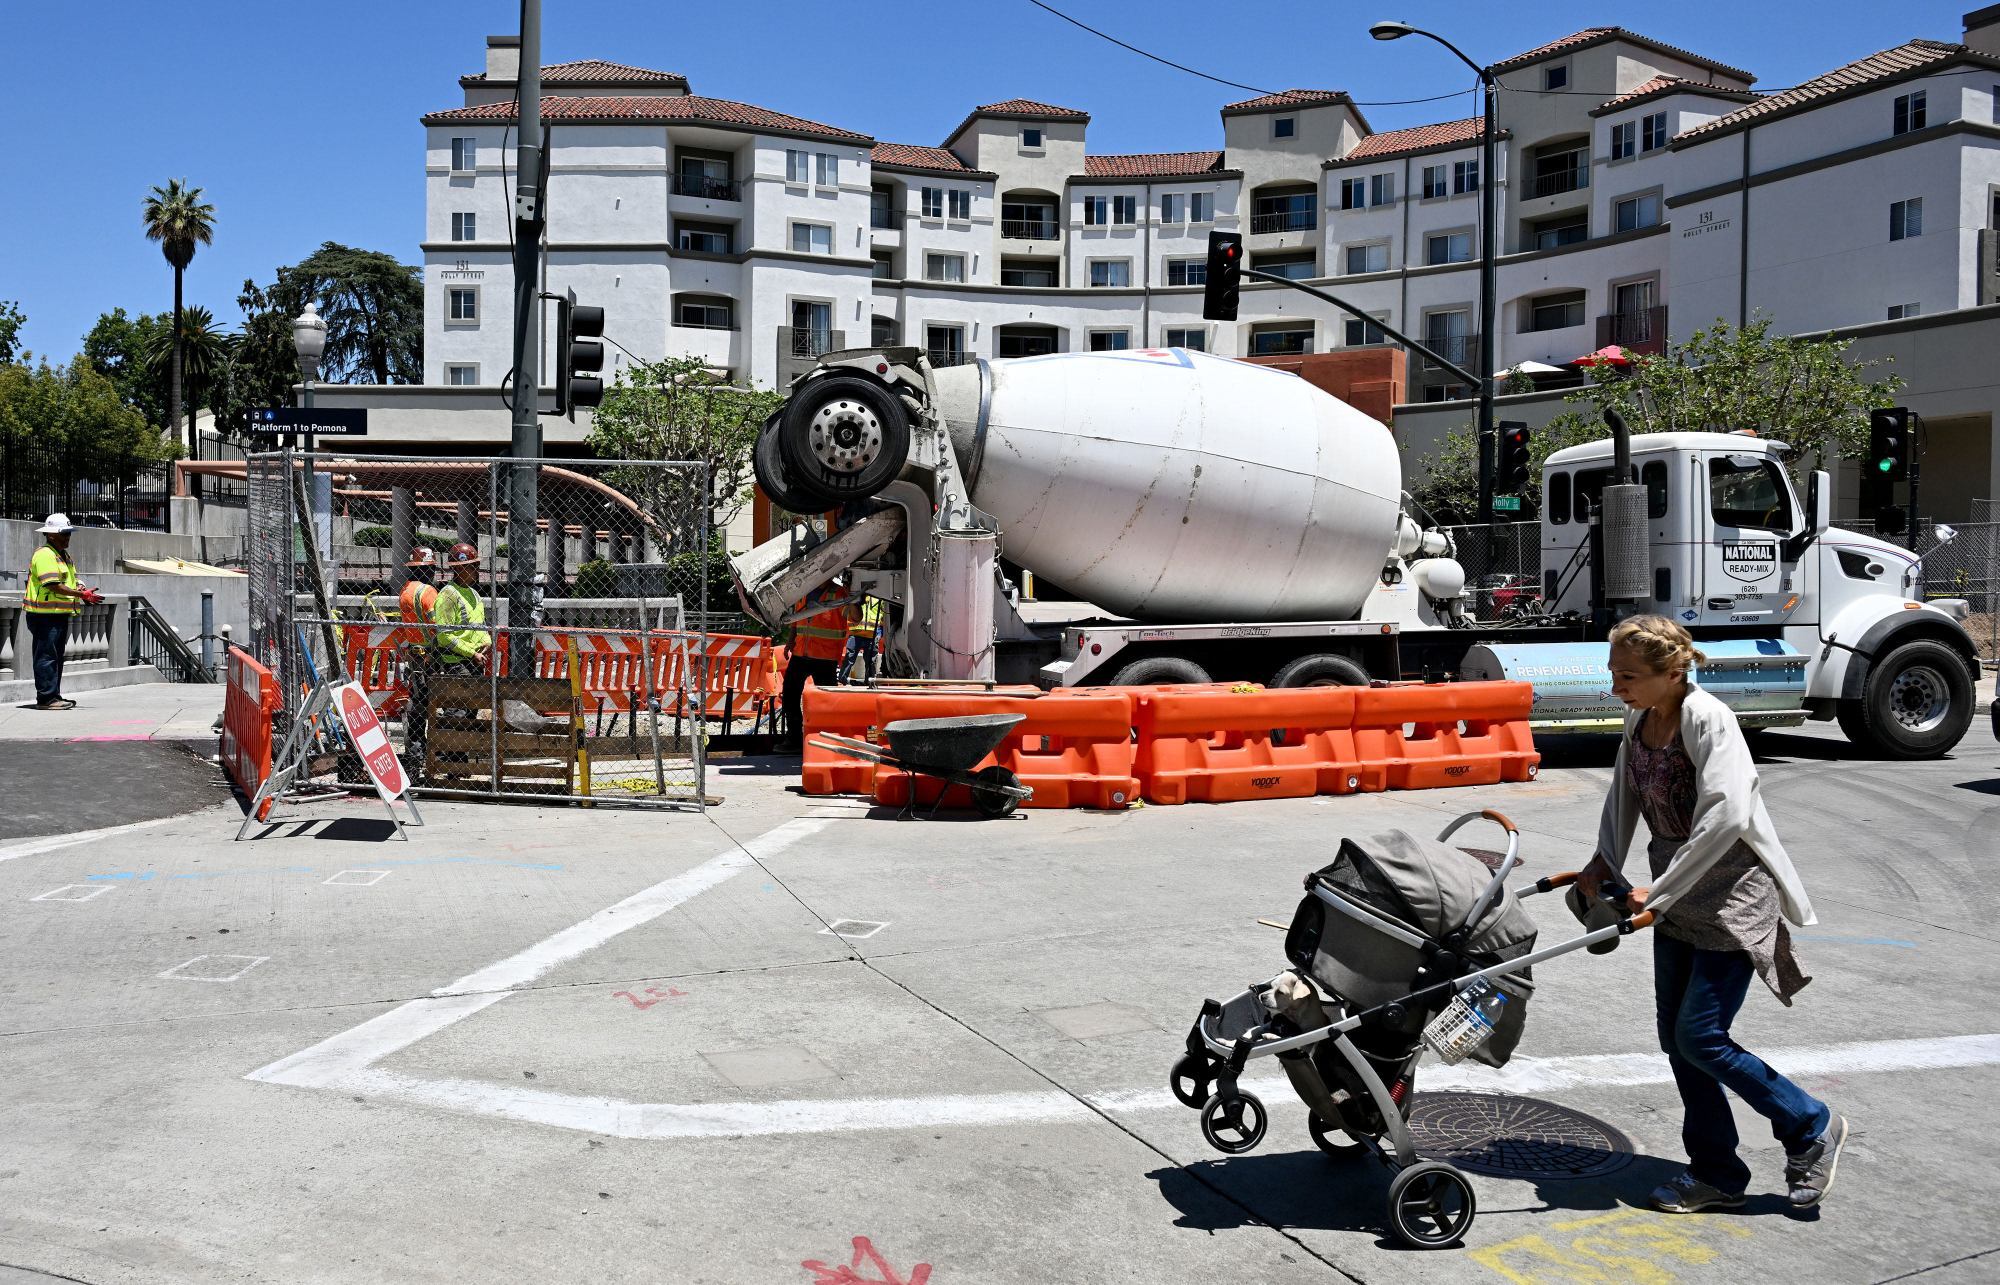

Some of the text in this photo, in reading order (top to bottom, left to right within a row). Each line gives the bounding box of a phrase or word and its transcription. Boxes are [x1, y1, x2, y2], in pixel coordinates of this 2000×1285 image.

[1700, 211, 1712, 223] 131
[1706, 222, 1730, 232] STREET
[252, 423, 291, 431] Platform
[293, 423, 298, 431] 1
[311, 424, 347, 432] Pomona
[1493, 498, 1509, 508] Holly
[1725, 546, 1772, 559] NATIONAL
[1741, 585, 1758, 593] (626)
[1221, 628, 1271, 636] BridgeKing
[1516, 664, 1596, 677] RENEWABLE
[347, 704, 372, 729] DO NOT
[374, 752, 394, 776] ENTER
[1251, 777, 1280, 786] YODOCK
